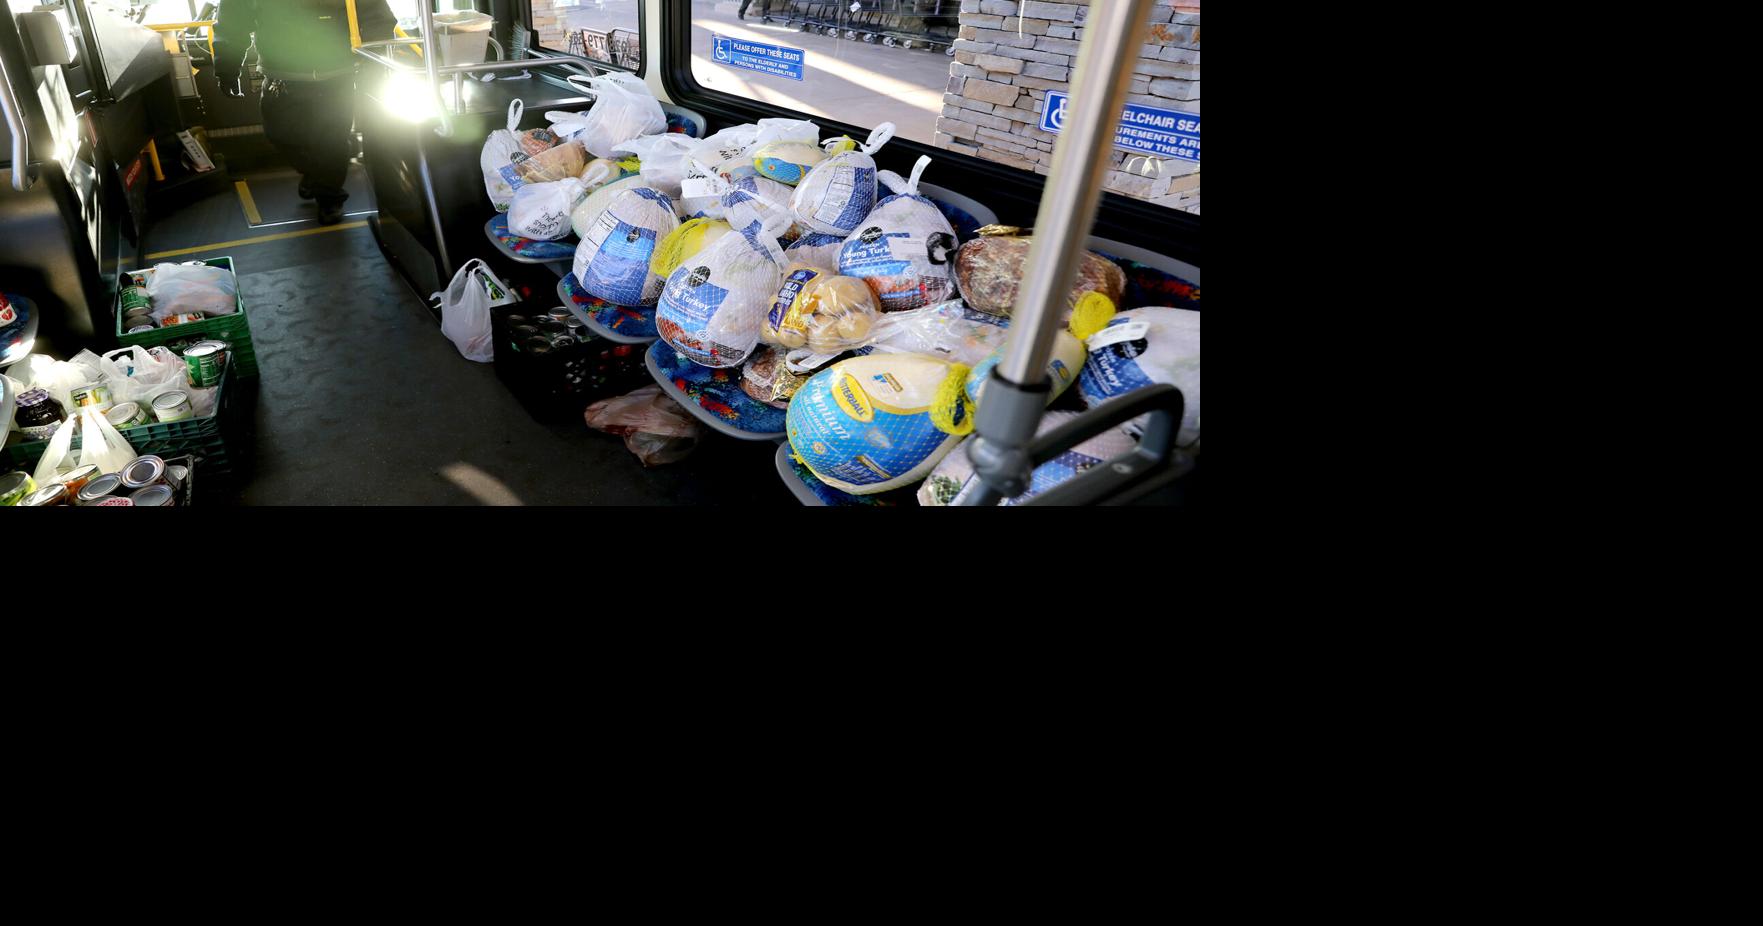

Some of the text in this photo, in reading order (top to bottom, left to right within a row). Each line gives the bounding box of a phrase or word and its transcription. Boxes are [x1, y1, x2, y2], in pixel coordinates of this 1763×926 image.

[733, 42, 800, 62] PLEASE OFFER THESE SEATS
[734, 60, 754, 69] PERSONS
[766, 67, 797, 78] DISABILITIES
[758, 58, 778, 67] ELDERLY
[778, 62, 789, 70] AND
[1122, 110, 1176, 129] ELCHAIR
[1114, 135, 1195, 158] BELOW THESE
[843, 249, 867, 259] Young
[681, 291, 711, 312] Turkey
[1097, 353, 1123, 387] Turkey
[840, 376, 867, 417] TTERBALL
